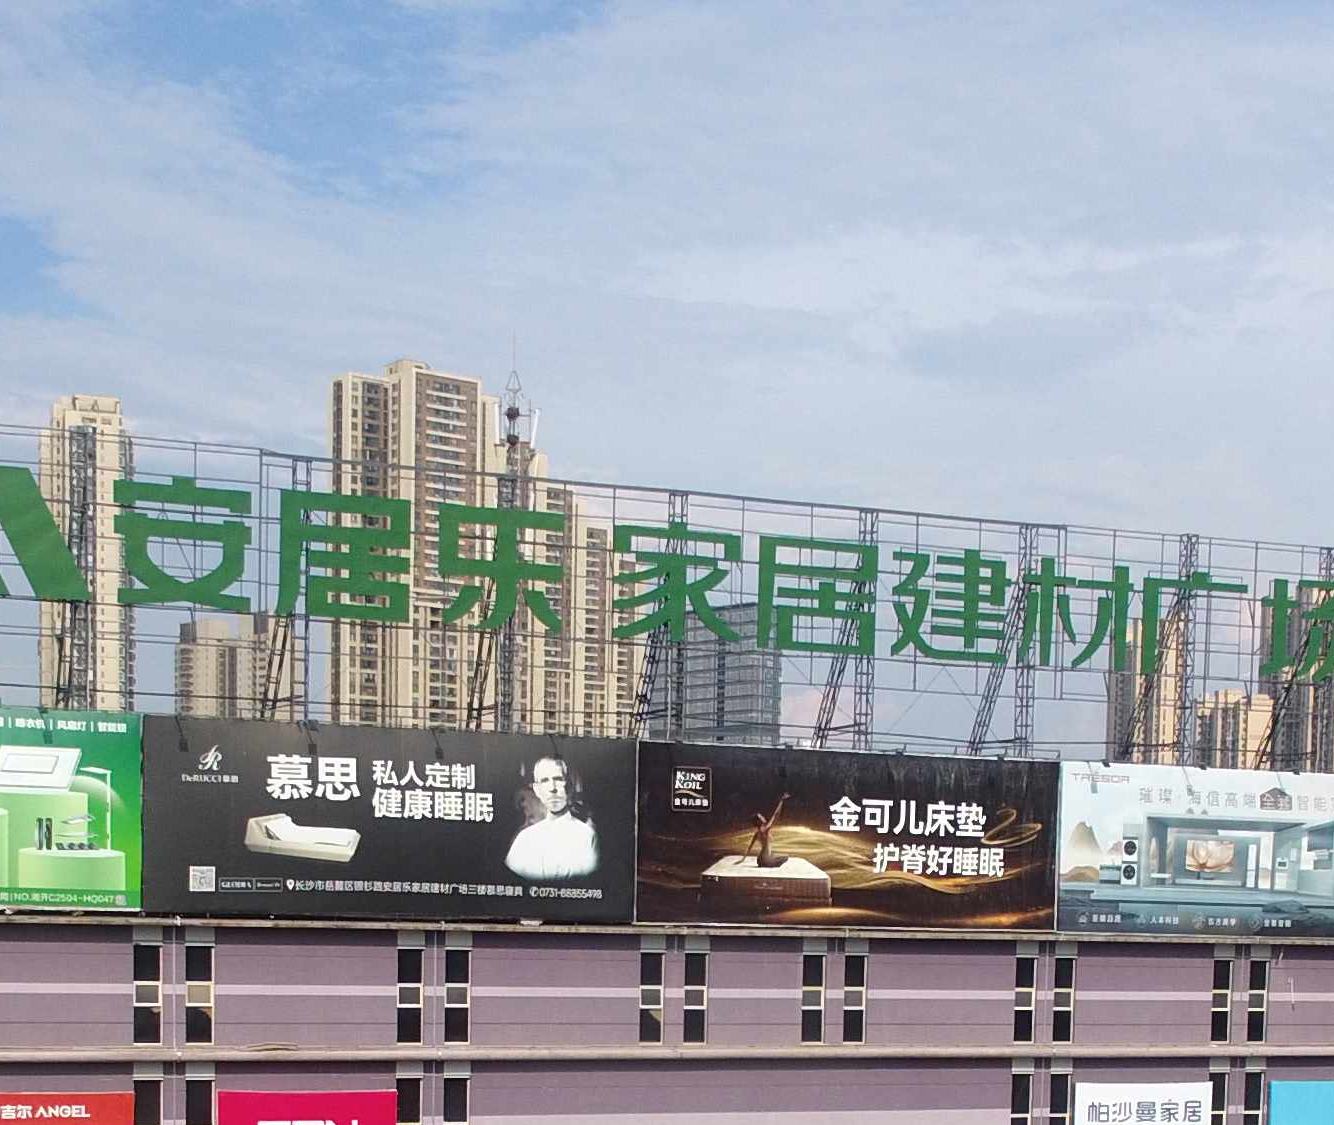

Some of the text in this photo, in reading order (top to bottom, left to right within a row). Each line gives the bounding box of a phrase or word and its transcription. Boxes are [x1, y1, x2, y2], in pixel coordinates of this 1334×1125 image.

[266, 754, 361, 801] 慕思
[372, 760, 476, 790] 私人定制
[675, 780, 703, 789] KOIL
[676, 771, 706, 782] KING
[372, 787, 494, 823] 健康睡眠
[829, 796, 986, 838] 金可儿床垫
[872, 843, 1004, 877] 护脊好睡眠
[35, 1104, 91, 1119] ANGEL
[1088, 1099, 1201, 1122] 帕沙曼家居
